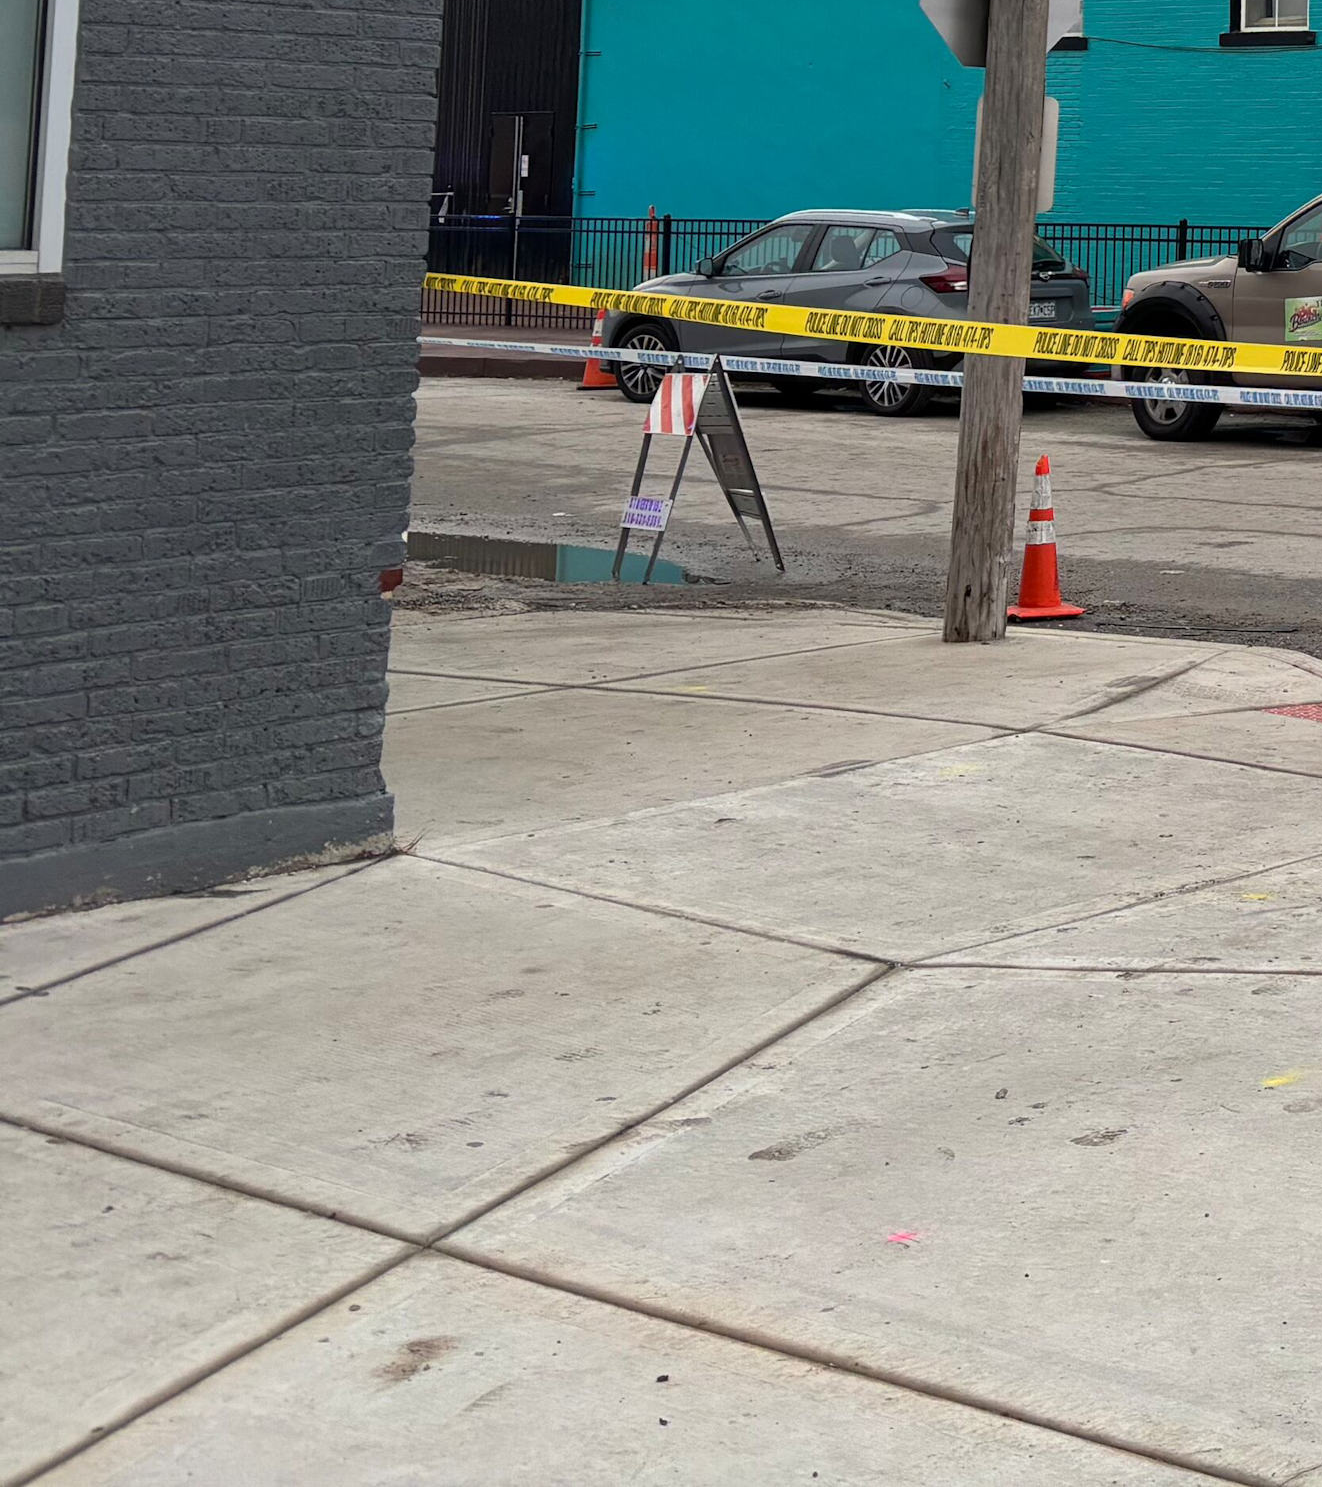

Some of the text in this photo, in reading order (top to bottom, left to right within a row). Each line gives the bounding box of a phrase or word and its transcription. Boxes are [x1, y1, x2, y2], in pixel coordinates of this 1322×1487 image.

[804, 312, 829, 334] POLICE
[826, 314, 843, 335] LINE
[840, 315, 852, 336] DO
[850, 316, 866, 337] NOT
[863, 317, 886, 339] CROSS
[888, 319, 905, 341] CALL
[904, 320, 922, 343] TIPS
[919, 322, 948, 345] HOTLINE
[1033, 332, 1059, 353] POLICE
[1056, 334, 1072, 355] LINE
[1070, 335, 1083, 356] DO
[1081, 336, 1098, 358] NOT
[1096, 337, 1119, 359] CROSS
[1123, 339, 1141, 361] CALL
[1141, 341, 1158, 363] TIPS
[1156, 342, 1186, 364] HOTLINE
[1203, 346, 1237, 368] 474-TIPS
[1281, 351, 1306, 372] POLICE
[1304, 352, 1321, 373] LINE
